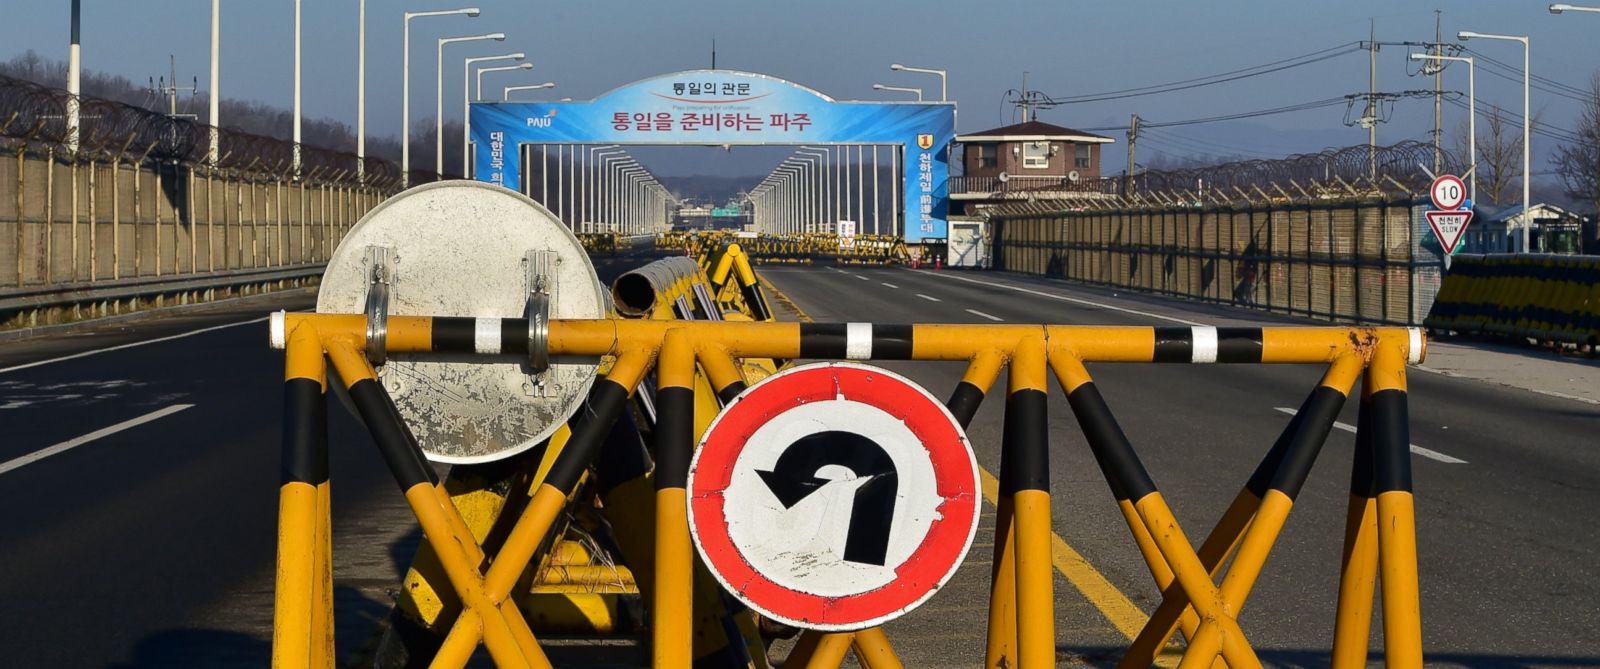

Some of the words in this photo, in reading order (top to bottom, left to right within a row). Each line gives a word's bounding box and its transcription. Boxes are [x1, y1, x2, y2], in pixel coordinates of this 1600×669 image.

[673, 82, 717, 96] 통일의
[721, 82, 751, 96] 관문
[527, 117, 551, 128] PAJU
[611, 112, 674, 132] 통일을
[679, 112, 764, 132] 준비하는
[769, 112, 812, 132] 파주
[921, 135, 930, 147] 1
[490, 131, 504, 170] 대한민국
[919, 152, 932, 192] 천하제일
[1441, 185, 1458, 200] 10
[1439, 216, 1462, 225] 천천히
